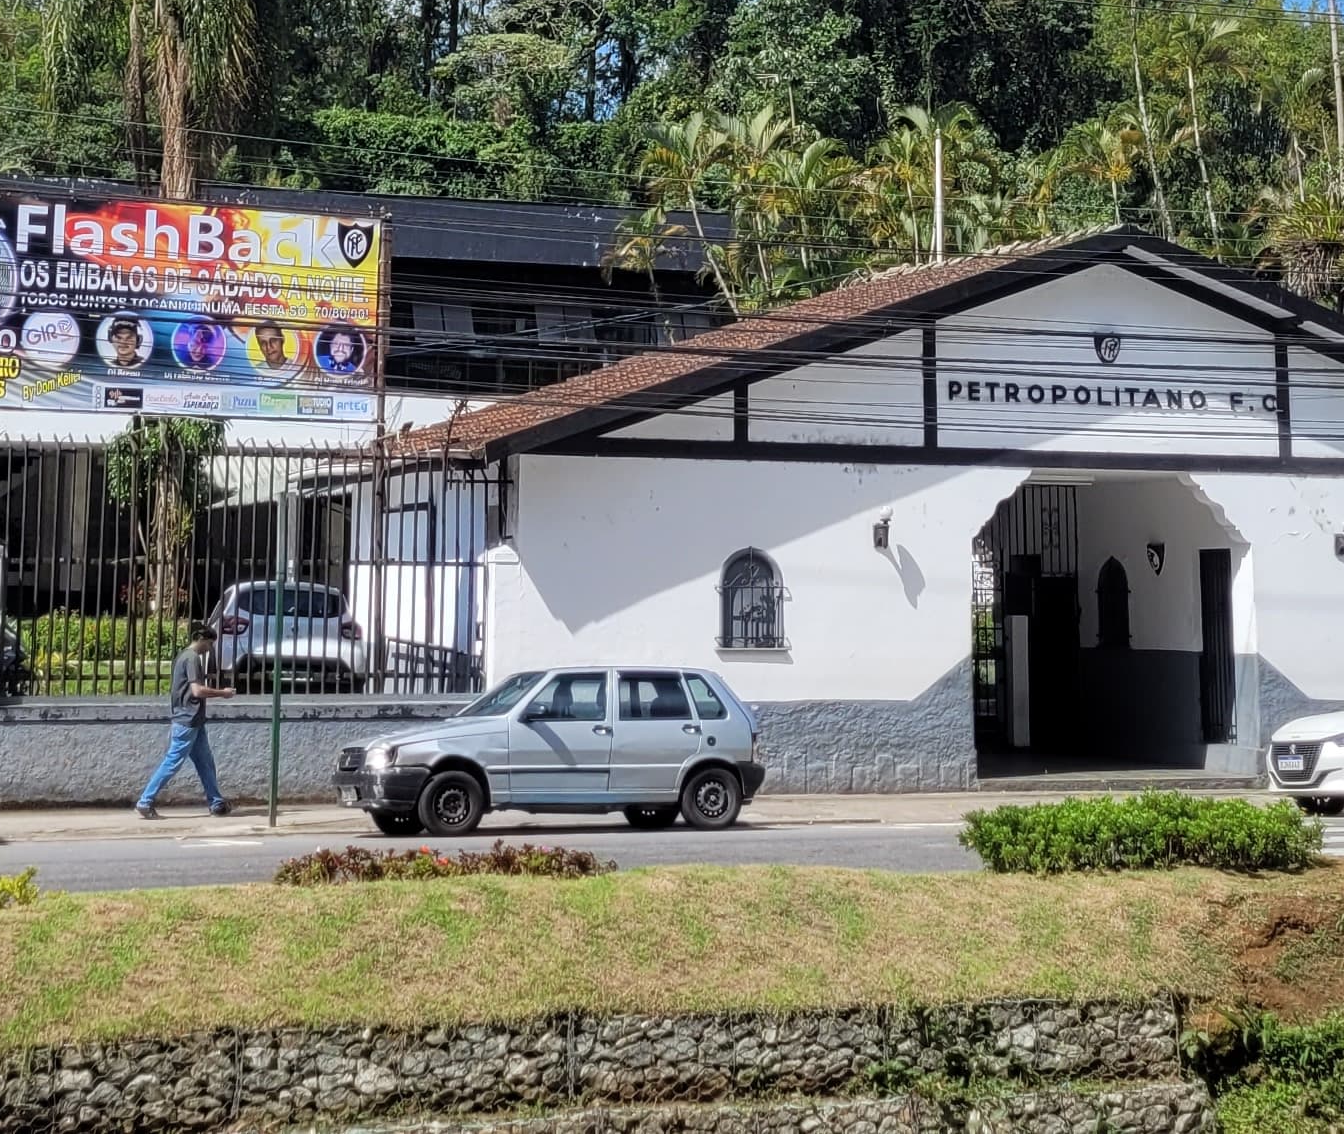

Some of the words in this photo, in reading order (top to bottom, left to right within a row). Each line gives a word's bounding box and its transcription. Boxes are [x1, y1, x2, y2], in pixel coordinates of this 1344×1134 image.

[16, 204, 337, 269] FlashBack
[20, 260, 50, 288] OS
[56, 261, 158, 293] EMBALOS
[164, 267, 193, 295] DE
[198, 264, 282, 298] SÁBADO
[287, 273, 302, 300] A
[20, 291, 68, 306] TODOS
[71, 293, 127, 309] JUNTOS
[201, 300, 240, 316] NUMA
[244, 302, 286, 316] FESTA
[22, 384, 34, 402] By
[36, 379, 56, 396] Dom
[948, 380, 1207, 408] PETROPOLITANO
